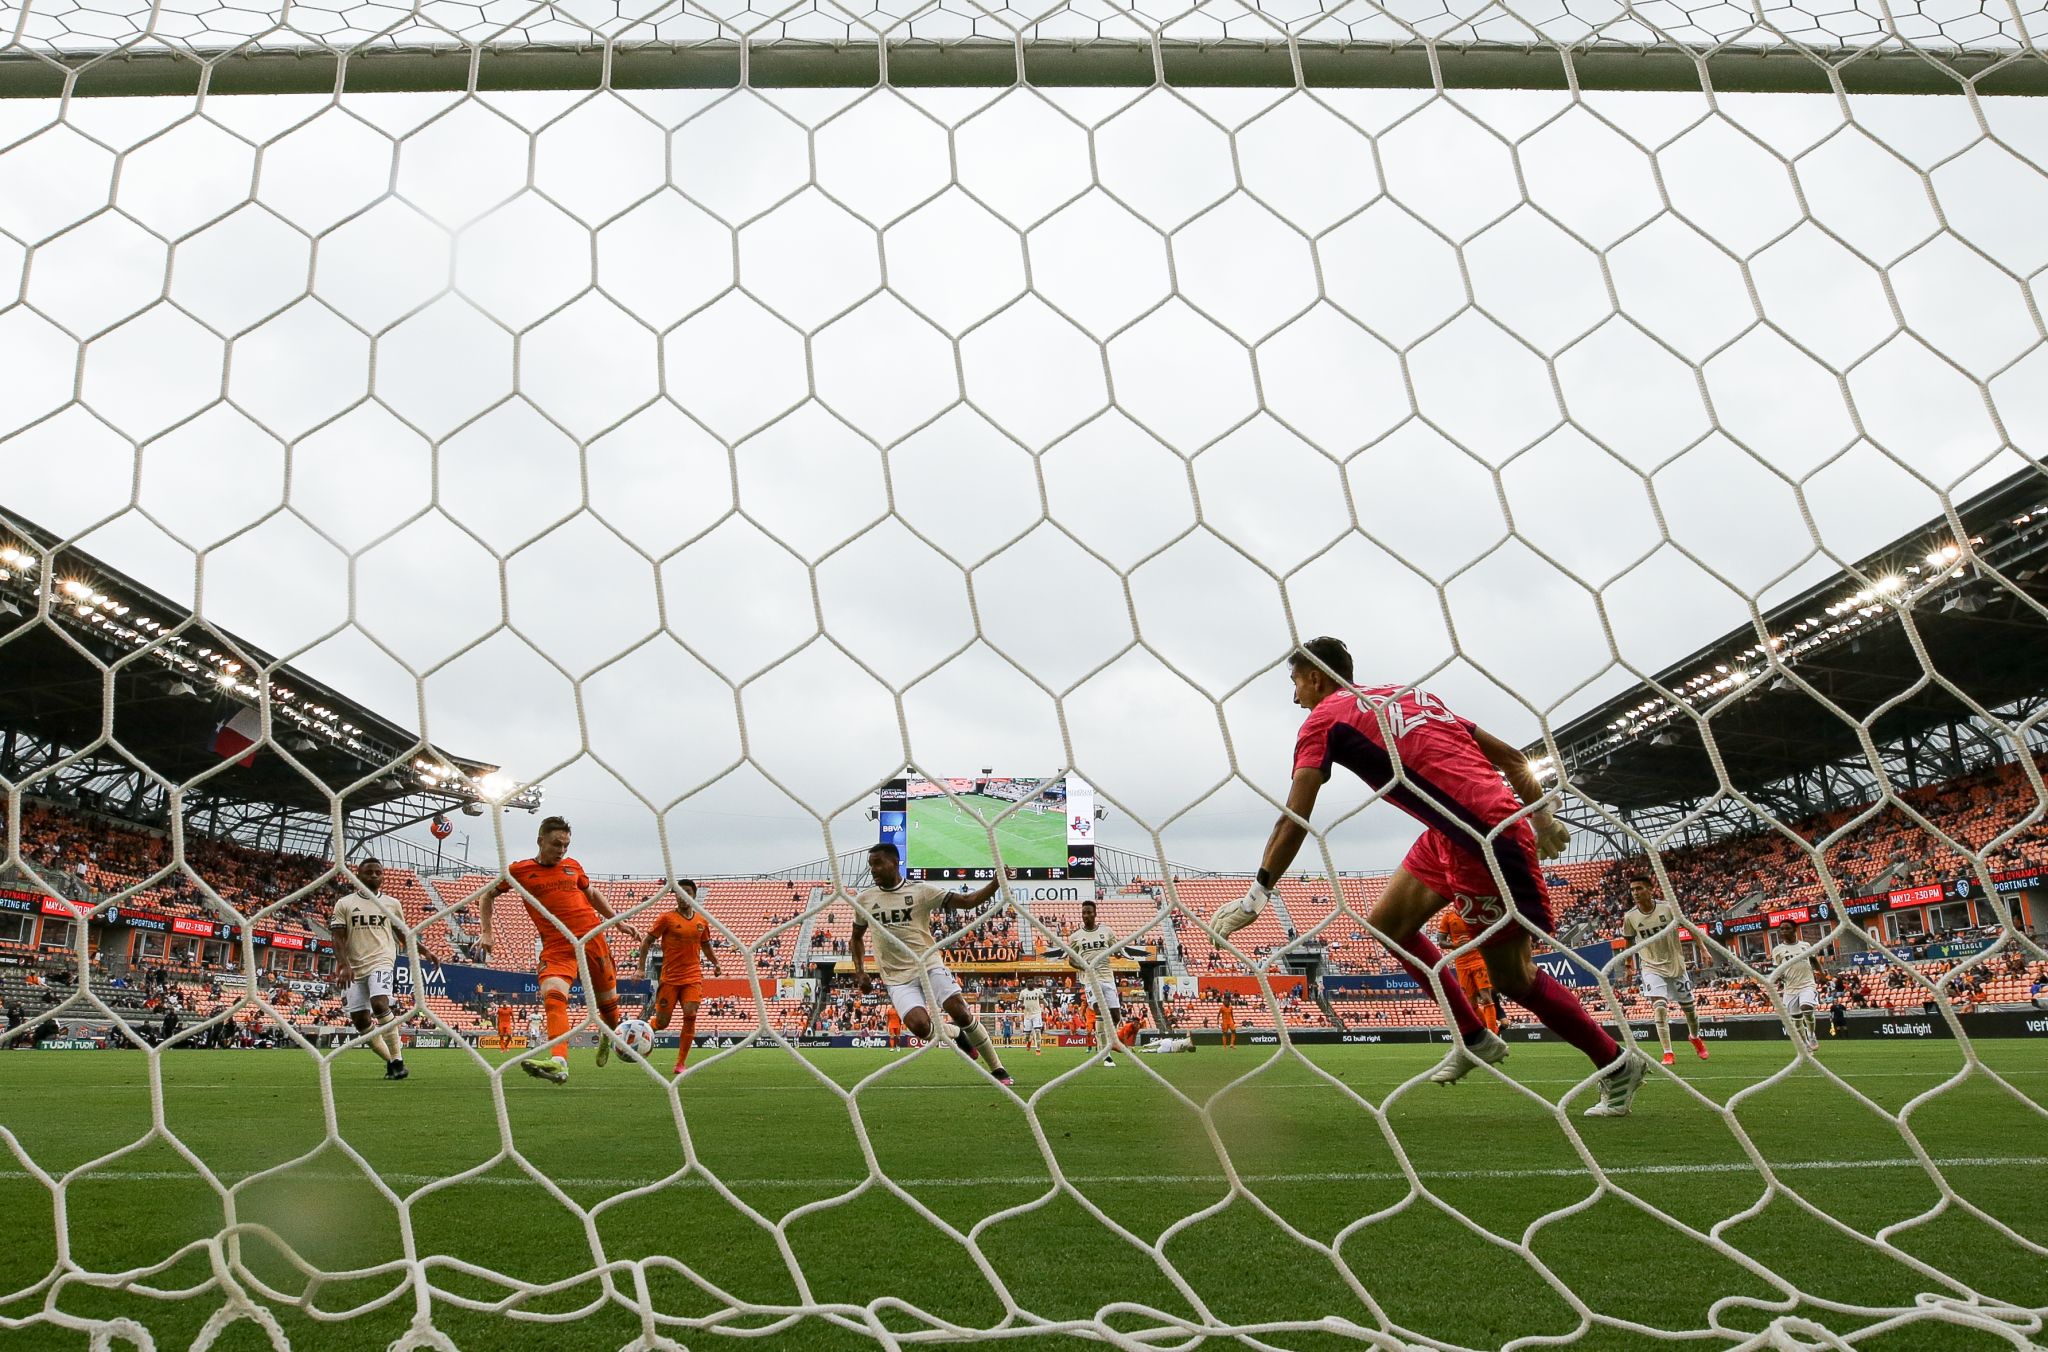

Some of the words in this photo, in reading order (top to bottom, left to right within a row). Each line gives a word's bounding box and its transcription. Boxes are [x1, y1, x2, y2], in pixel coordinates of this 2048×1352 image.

[437, 821, 451, 832] 76
[943, 869, 950, 877] 0
[1026, 869, 1031, 877] 1
[1994, 880, 2028, 891] PORTING
[2028, 877, 2040, 887] KC
[1891, 895, 1903, 904] MAY
[1904, 893, 1911, 902] 12
[1929, 888, 1940, 898] PM
[0, 898, 21, 908] RTING
[1453, 892, 1503, 925] 23
[1846, 904, 1871, 914] PORTING
[352, 914, 387, 927] FLEX
[872, 908, 912, 924] FLEX
[1082, 940, 1105, 950] FLEX
[1951, 942, 1983, 951] TRIEAGLE
[943, 947, 1019, 962] ATALLON
[1536, 958, 1575, 978] BVA
[1386, 980, 1420, 988] bbvaus
[1676, 981, 1691, 992] 20
[1882, 1023, 1894, 1035] 5G
[1895, 1023, 1912, 1034] built
[1913, 1023, 1931, 1036] right
[2026, 1016, 2048, 1032] veri
[1250, 1035, 1277, 1043] verizon
[1367, 1035, 1380, 1043] right
[1632, 1028, 1649, 1039] erizon
[42, 1040, 72, 1049] TUDN
[1066, 1037, 1086, 1045] Audi
